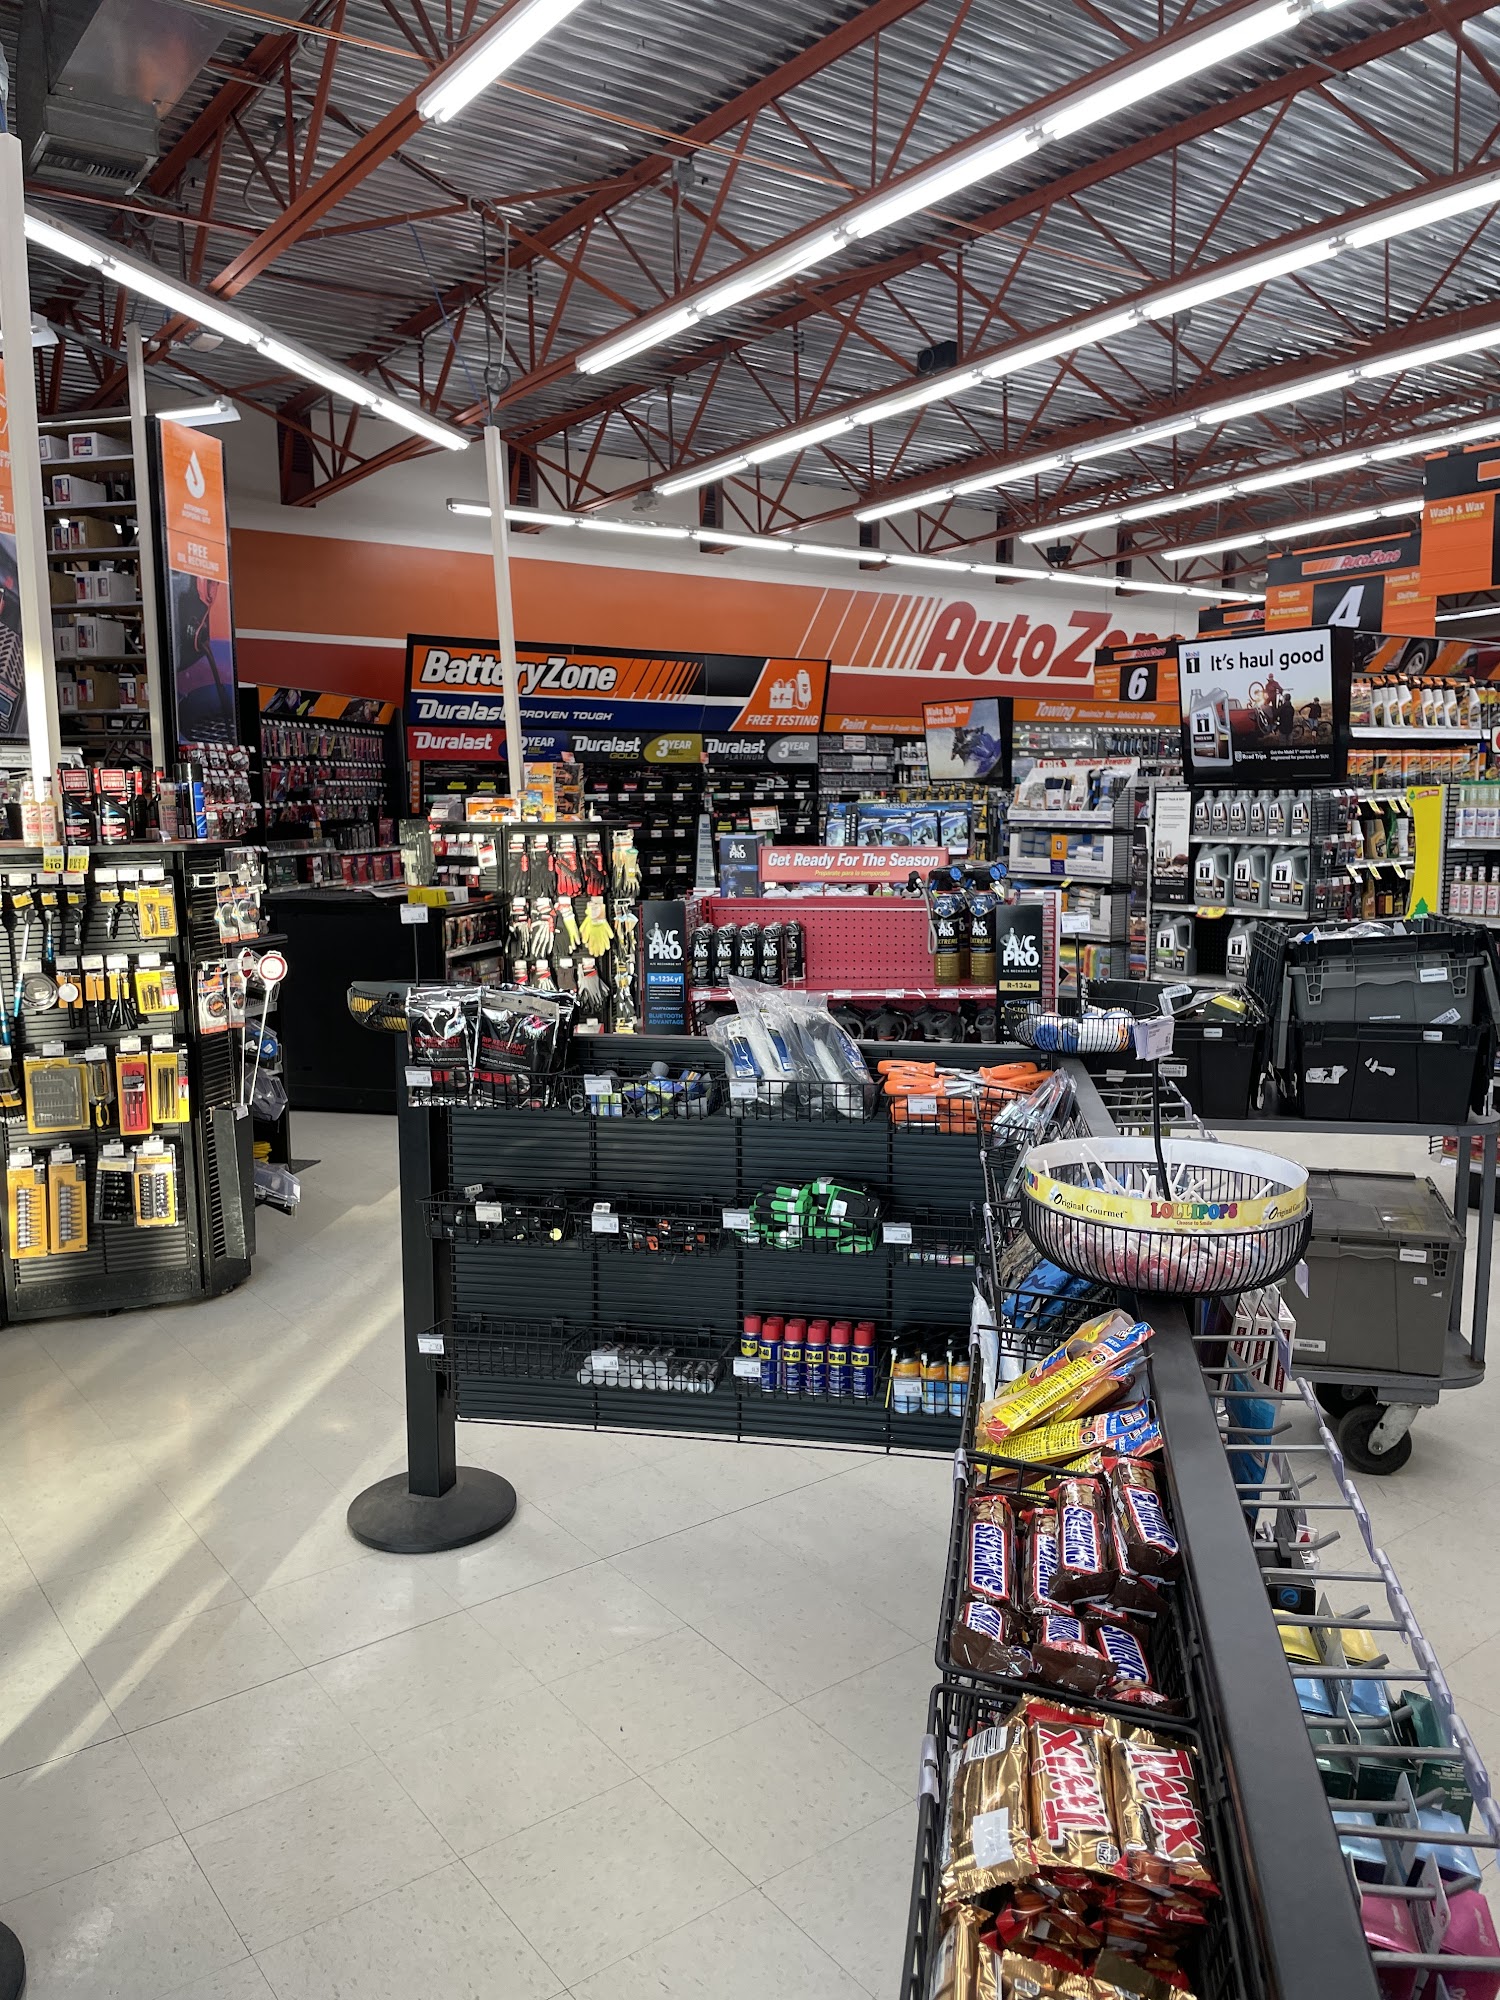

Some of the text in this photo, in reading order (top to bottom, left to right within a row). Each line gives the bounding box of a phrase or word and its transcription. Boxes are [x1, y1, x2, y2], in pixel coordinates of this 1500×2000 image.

[1430, 501, 1486, 518] Wash & Wax
[187, 541, 209, 559] FREE
[176, 552, 220, 572] OIL RECYCLING
[1340, 548, 1402, 570] AutoZone
[1278, 588, 1301, 600] Gauges
[1396, 590, 1419, 601] Shifter
[1270, 604, 1309, 616] Performance
[1327, 584, 1365, 628] 4
[916, 600, 1183, 678] AutoZ
[1210, 643, 1324, 672] It's haul good
[420, 648, 618, 696] BatteryZone
[1127, 666, 1149, 701] 6
[519, 710, 569, 720] PROVEN
[572, 710, 613, 721] TOUGH
[926, 706, 944, 717] Wake
[954, 704, 970, 715] Your
[1035, 701, 1077, 721] Towing
[745, 714, 820, 727] FREE TESTING
[839, 717, 868, 731] Paint
[927, 715, 957, 726] Weekend
[413, 731, 493, 751] Duralast
[528, 736, 555, 748] YEAR
[572, 735, 642, 753] Duralast
[656, 739, 692, 758] 3 YEAR
[704, 738, 766, 755] Duralast
[778, 741, 810, 758] 3 YEAR
[609, 752, 640, 760] GOLD
[724, 753, 764, 761] PLATINUM
[1074, 757, 1133, 767] AutoZone Rewards
[1242, 753, 1268, 762] Road Trips
[767, 852, 940, 870] Get Ready For The Season
[841, 870, 854, 878] para
[860, 869, 891, 878] temporada
[651, 929, 680, 945] A/C
[1006, 934, 1037, 951] A/C
[650, 975, 682, 985] R-1234yf
[1006, 981, 1032, 990] R-134a
[481, 1035, 493, 1044] RIP
[1054, 1193, 1084, 1212] Original
[1150, 1201, 1238, 1220] LOLLIPOPS
[1268, 1206, 1293, 1220] Original
[741, 1341, 756, 1349] WD-40
[1104, 1337, 1122, 1350] BEEF
[783, 1350, 800, 1359] WD-40
[806, 1352, 823, 1361] WD-40
[829, 1353, 846, 1361] WD-40
[852, 1355, 868, 1363] WD-40
[1098, 1415, 1109, 1443] CHEESE
[1110, 1417, 1118, 1435] BEEF
[1118, 1435, 1127, 1453] BEEF
[1063, 1506, 1095, 1569] SNICKERS
[973, 1523, 1004, 1596] SNICKERS
[1038, 1728, 1109, 1842] TWIX
[1130, 1749, 1205, 1855] TWIX
[1097, 1842, 1110, 1863] 250
